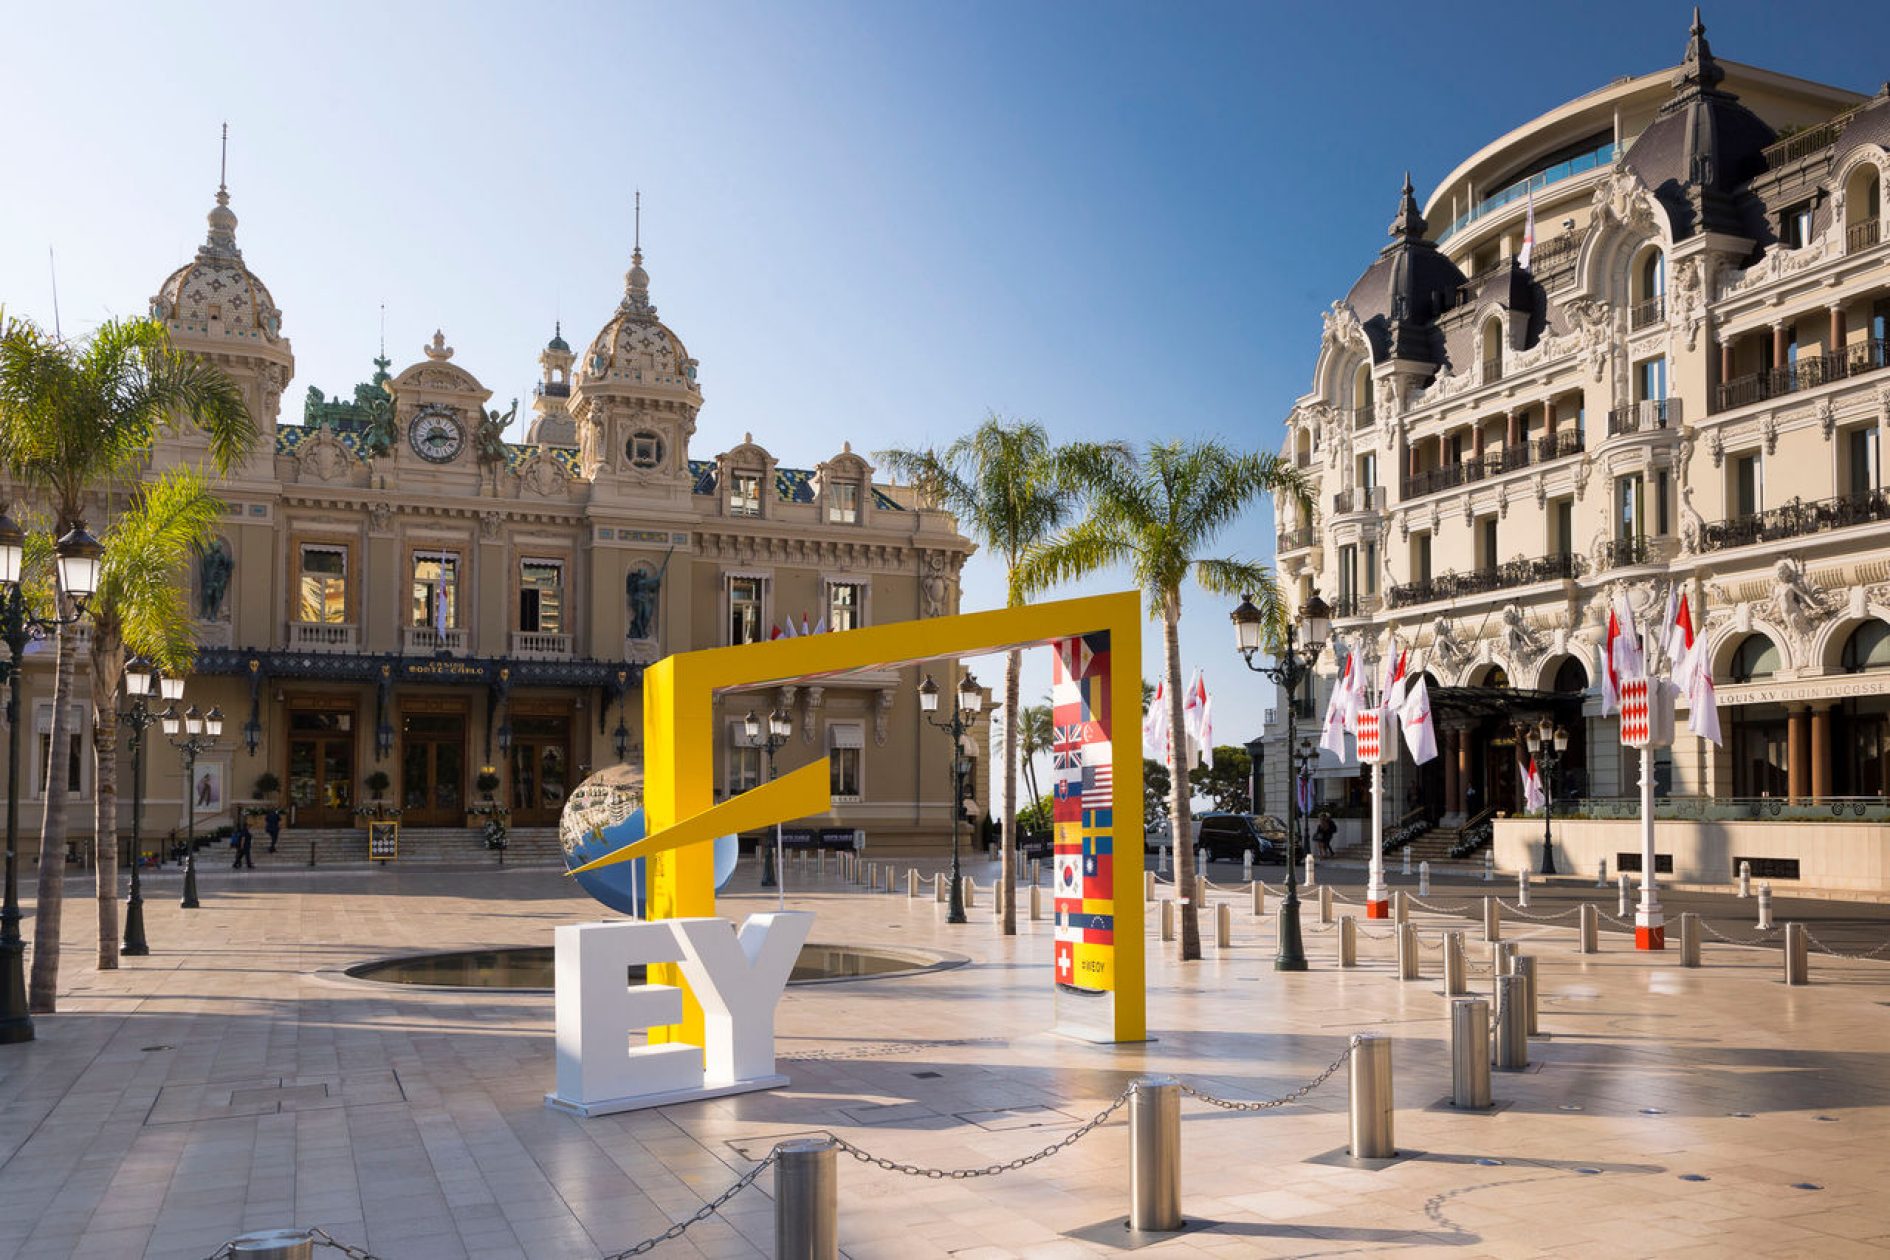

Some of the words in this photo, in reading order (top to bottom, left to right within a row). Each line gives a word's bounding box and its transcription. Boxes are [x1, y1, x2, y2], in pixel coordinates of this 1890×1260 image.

[1719, 694, 1755, 704] LOUIS
[1761, 692, 1776, 701] XV
[1781, 688, 1819, 700] ALAIN
[1826, 682, 1885, 697] DUCASSE
[555, 911, 816, 1104] EY
